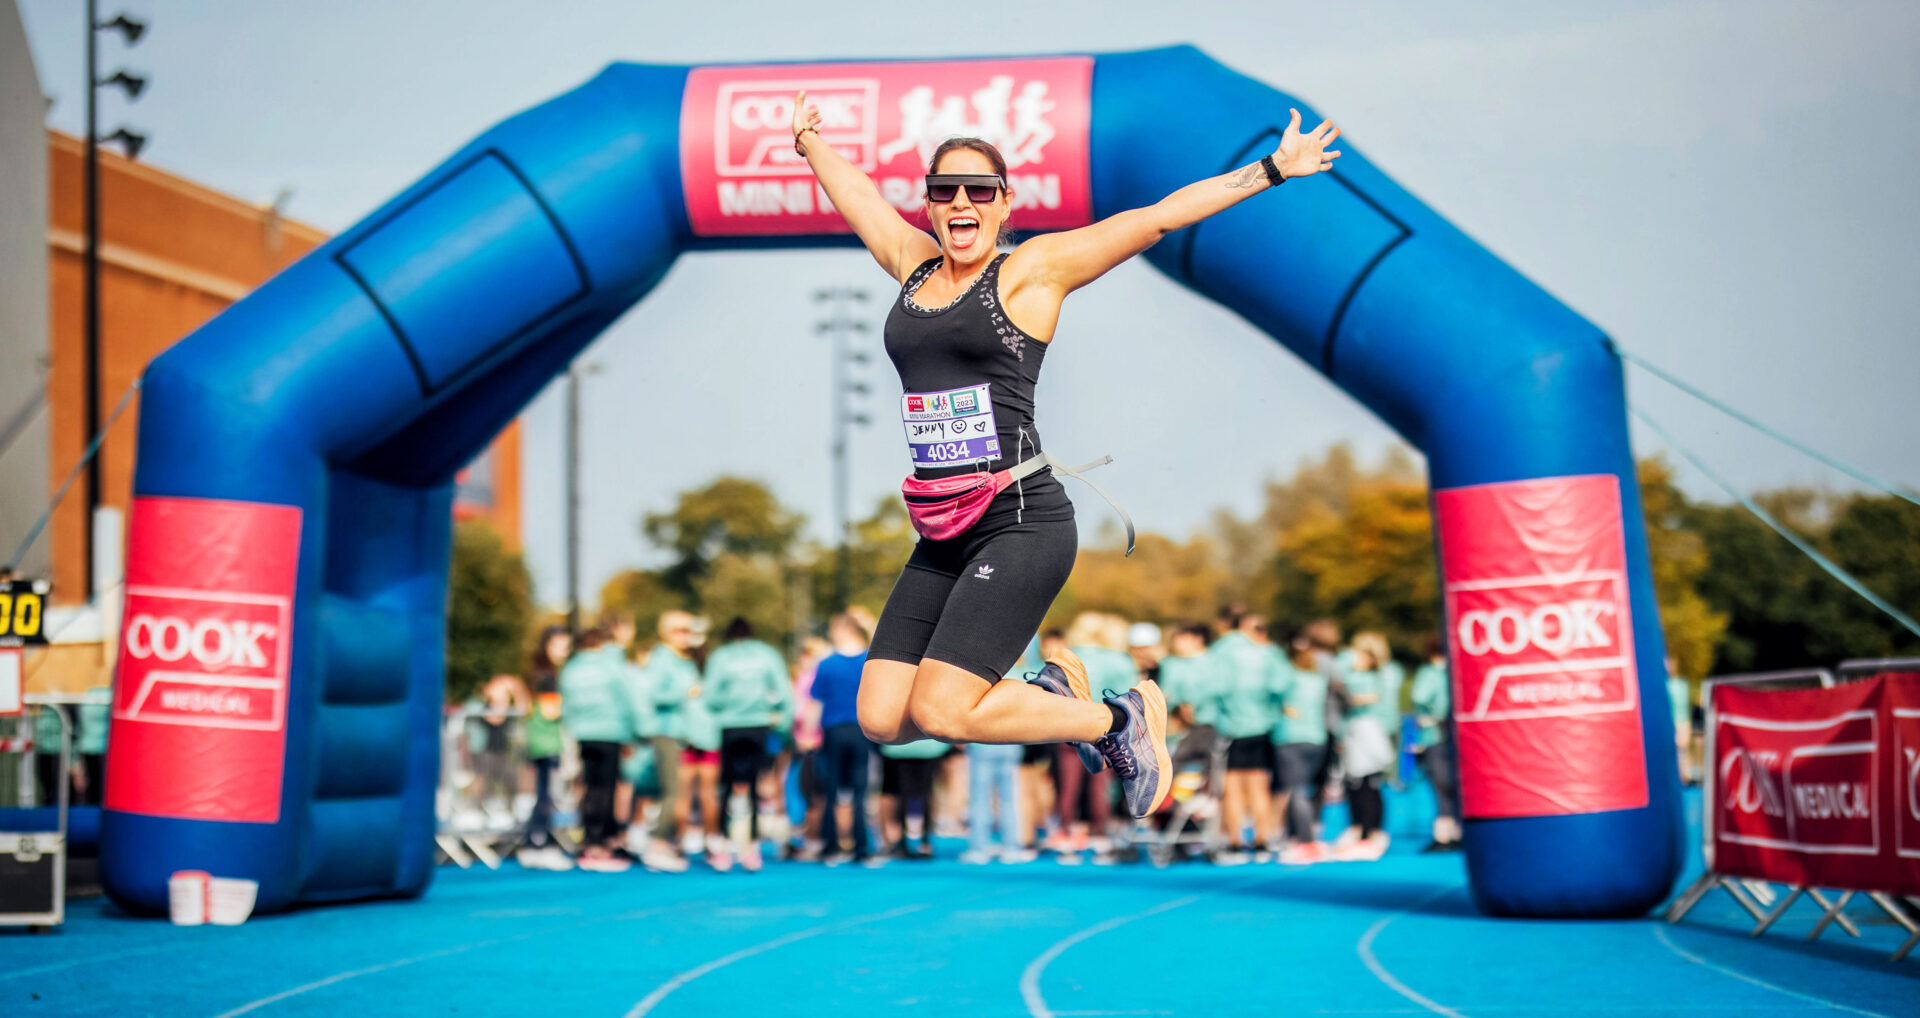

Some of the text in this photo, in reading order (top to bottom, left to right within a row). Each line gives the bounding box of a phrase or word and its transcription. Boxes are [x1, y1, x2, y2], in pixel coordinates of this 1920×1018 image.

[716, 181, 815, 217] MINI
[956, 400, 973, 408] 2023
[920, 411, 951, 419] MARATHON
[913, 423, 944, 439] JENNY
[928, 441, 970, 461] 4034
[1458, 600, 1615, 656] COOK
[127, 614, 276, 668] COOK
